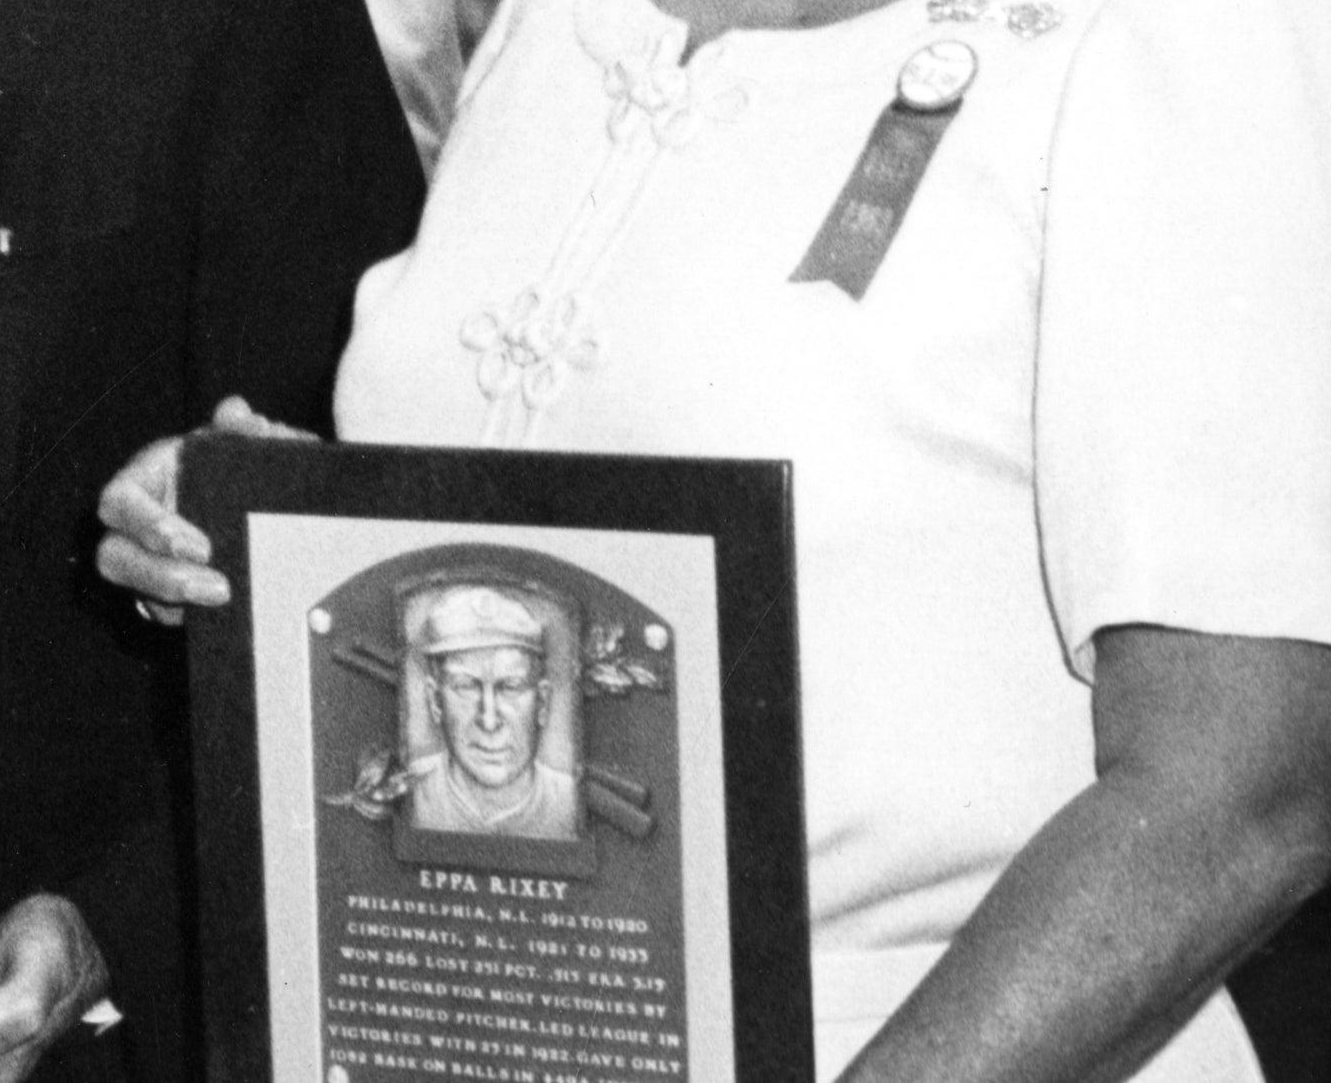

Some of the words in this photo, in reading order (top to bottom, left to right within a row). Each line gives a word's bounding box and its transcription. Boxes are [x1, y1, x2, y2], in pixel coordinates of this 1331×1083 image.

[418, 868, 478, 893] EPPA
[488, 874, 569, 901] RIXEY
[346, 894, 493, 922] PHILADELPHIA,
[498, 908, 535, 924] N.L.
[580, 915, 603, 931] TO
[344, 922, 465, 947] CINCINNATI,
[474, 934, 516, 951] N.L.
[575, 943, 603, 959] TO
[339, 945, 380, 964] WON
[424, 955, 469, 973] LOST
[587, 971, 626, 988] ERA
[337, 973, 370, 989] SET
[375, 976, 448, 998] RECORD
[451, 984, 484, 1001] FOR
[489, 989, 534, 1006] MOST
[540, 993, 638, 1016] VICTORIES
[642, 1002, 668, 1020] BY
[326, 998, 448, 1022] LEFT-HANDED
[538, 1020, 574, 1036] LED
[578, 1024, 650, 1045] LEAGUE
[658, 1031, 680, 1048] IN
[327, 1024, 422, 1046] VICTORIES
[428, 1034, 476, 1053] WITH
[503, 1043, 526, 1058] IN
[575, 1050, 626, 1069] GAVE
[630, 1055, 682, 1074] ONLY
[373, 1053, 417, 1070] BASE
[422, 1059, 447, 1072] ON
[451, 1061, 510, 1082] BALLS
